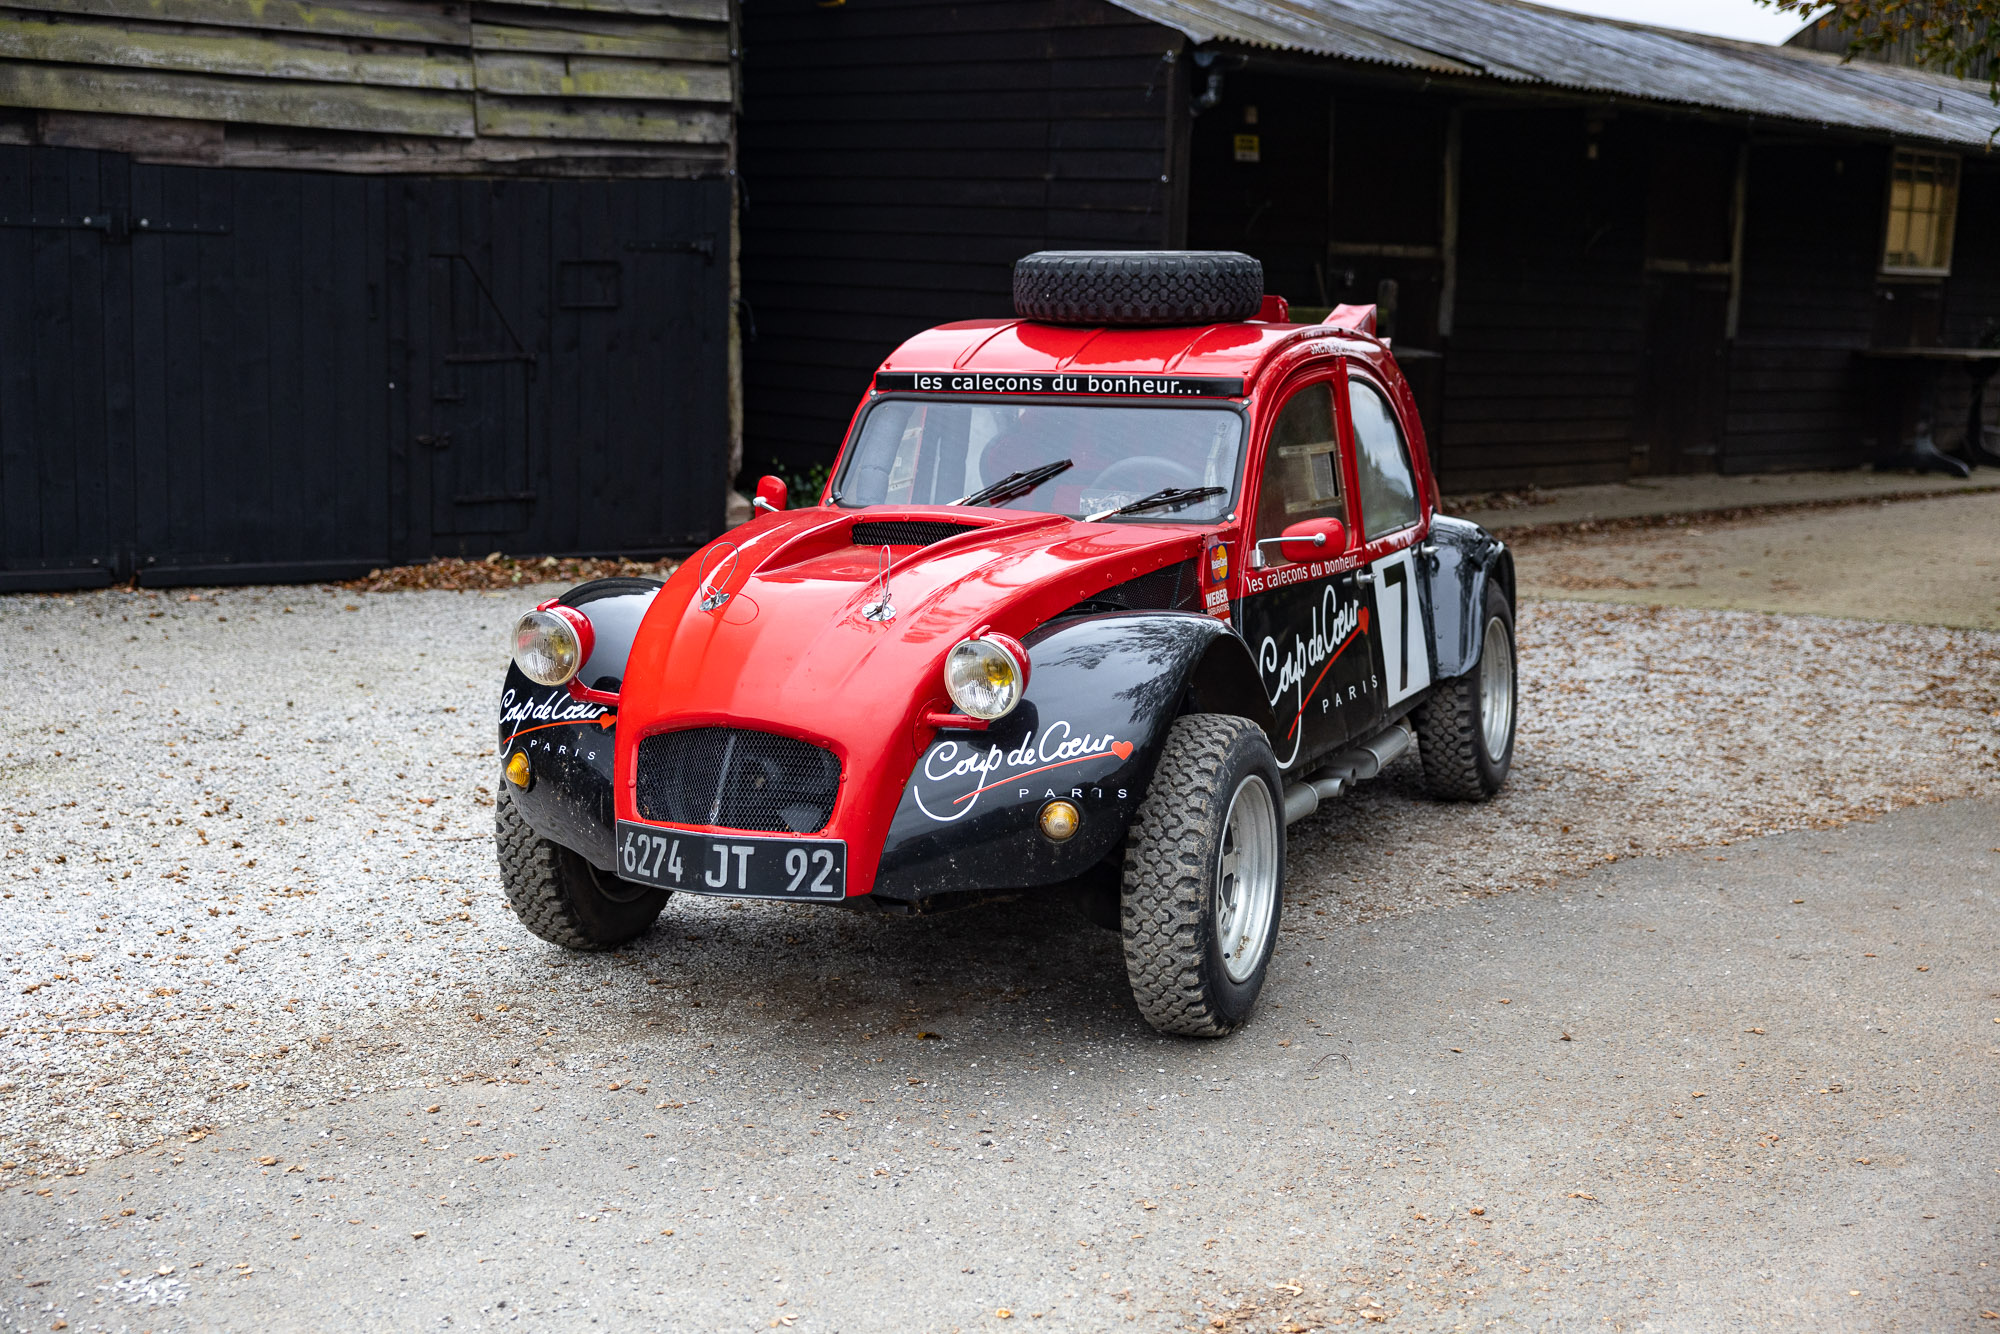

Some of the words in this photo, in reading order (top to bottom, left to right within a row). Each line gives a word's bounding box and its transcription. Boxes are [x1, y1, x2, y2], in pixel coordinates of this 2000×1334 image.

[913, 373, 943, 391] les
[951, 373, 1043, 393] caleçons
[1052, 374, 1078, 392] du
[1088, 375, 1202, 395] bonheur...
[1245, 576, 1264, 593] les
[1267, 566, 1309, 585] caleçons
[1311, 562, 1322, 577] du
[1205, 588, 1229, 608] WEBER
[1308, 606, 1325, 666] de
[1383, 561, 1408, 693] 7
[532, 691, 558, 719] de
[1322, 674, 1378, 713] PARIS
[530, 739, 596, 760] PARIS
[1007, 730, 1037, 766] de
[1019, 788, 1128, 799] PARIS
[623, 831, 684, 883] 6274
[704, 844, 755, 890] JT
[785, 848, 834, 893] 92
